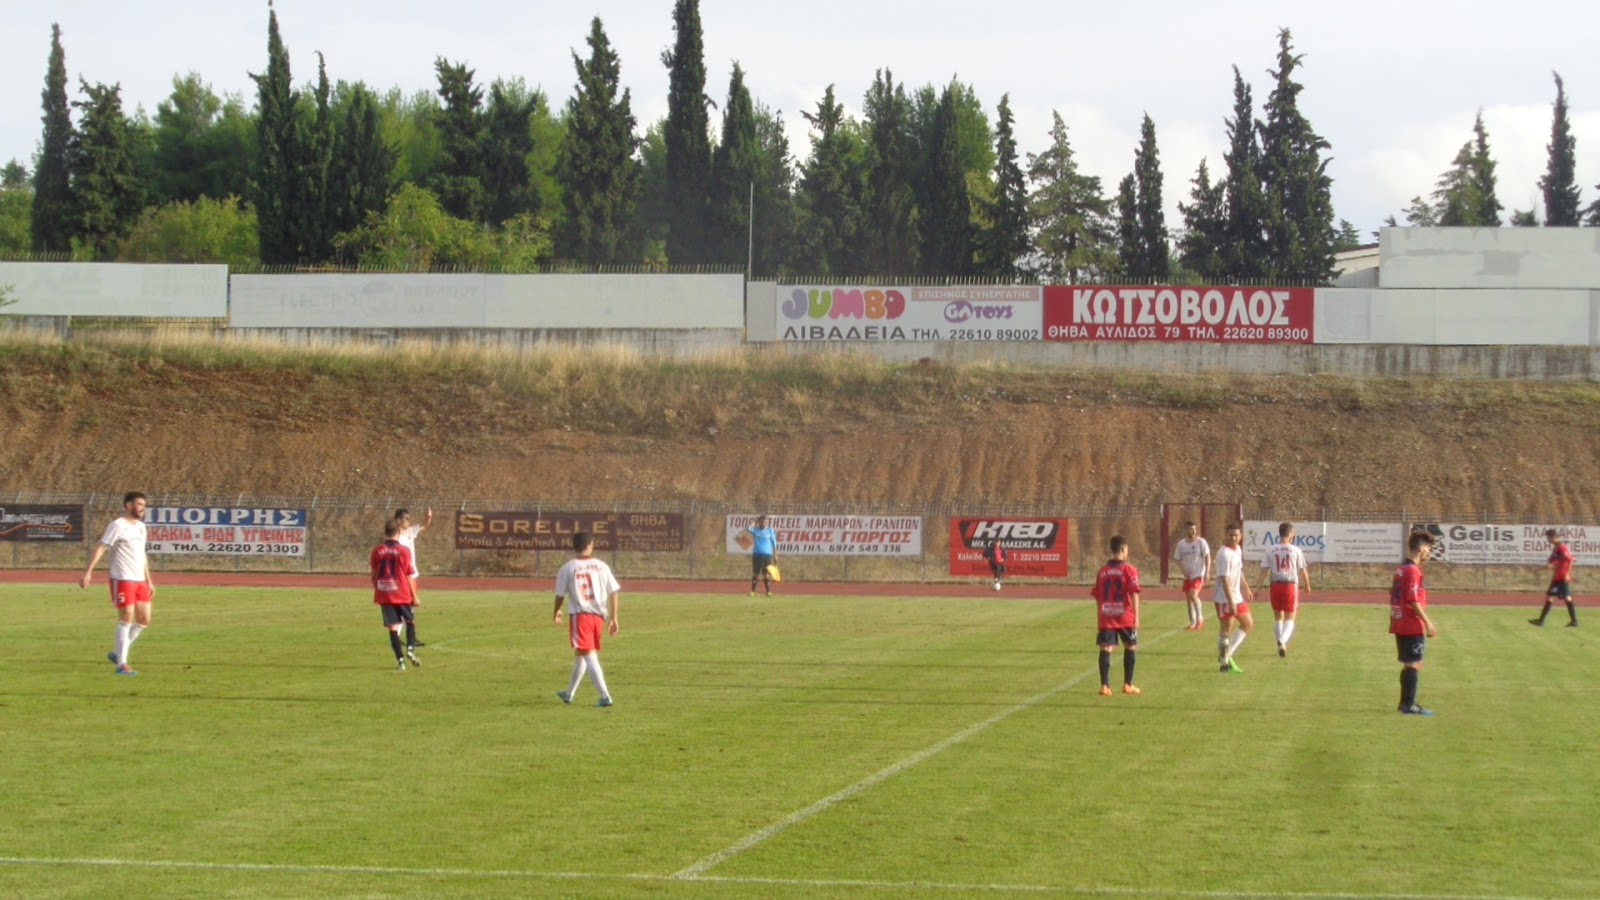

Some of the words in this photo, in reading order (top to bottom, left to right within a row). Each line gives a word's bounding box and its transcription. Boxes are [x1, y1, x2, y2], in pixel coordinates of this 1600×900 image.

[919, 290, 967, 299] ΕΠΙΣΗΜΟΣ
[970, 290, 1031, 299] ΣΥΝΕΡΓΑΤΗΣ
[782, 288, 905, 320] JUMBO
[1073, 288, 1290, 326] ΚΩΤΣΟΒΟΛΟΣ
[783, 325, 906, 340] ΛΙΒΑΔΕΙΑ
[911, 328, 944, 340] ΤΗΛ.
[949, 329, 992, 340] 22610
[996, 329, 1038, 340] 89002
[1048, 325, 1088, 338] ΘΗΒΑ
[1096, 326, 1157, 338] ΑΥΛΙΔΟΣ
[1164, 326, 1180, 338] 79
[1187, 327, 1219, 338] ΤΗΛ.
[1223, 328, 1264, 339] 22620
[1267, 328, 1309, 340] 89300
[459, 513, 609, 534] SORELLE
[630, 515, 667, 526] ΘΗΒΑ
[729, 517, 801, 529] ΤΟΠΤΗΣΕΙΣ
[243, 529, 304, 544] ΥΓΙΕΙΝΗΣ
[840, 531, 912, 543] ΓΙΩΡΓΟΣ
[1262, 531, 1326, 549] Λκος
[1449, 525, 1515, 542] Gelis
[1524, 527, 1587, 538] ΠΛΑΑΚΙΑ
[172, 543, 203, 551] ΤΗΛ.
[209, 543, 251, 552] 22620
[255, 544, 299, 553] 23309
[1524, 541, 1551, 552] ΕΙΔΗ
[1274, 553, 1292, 573] 14
